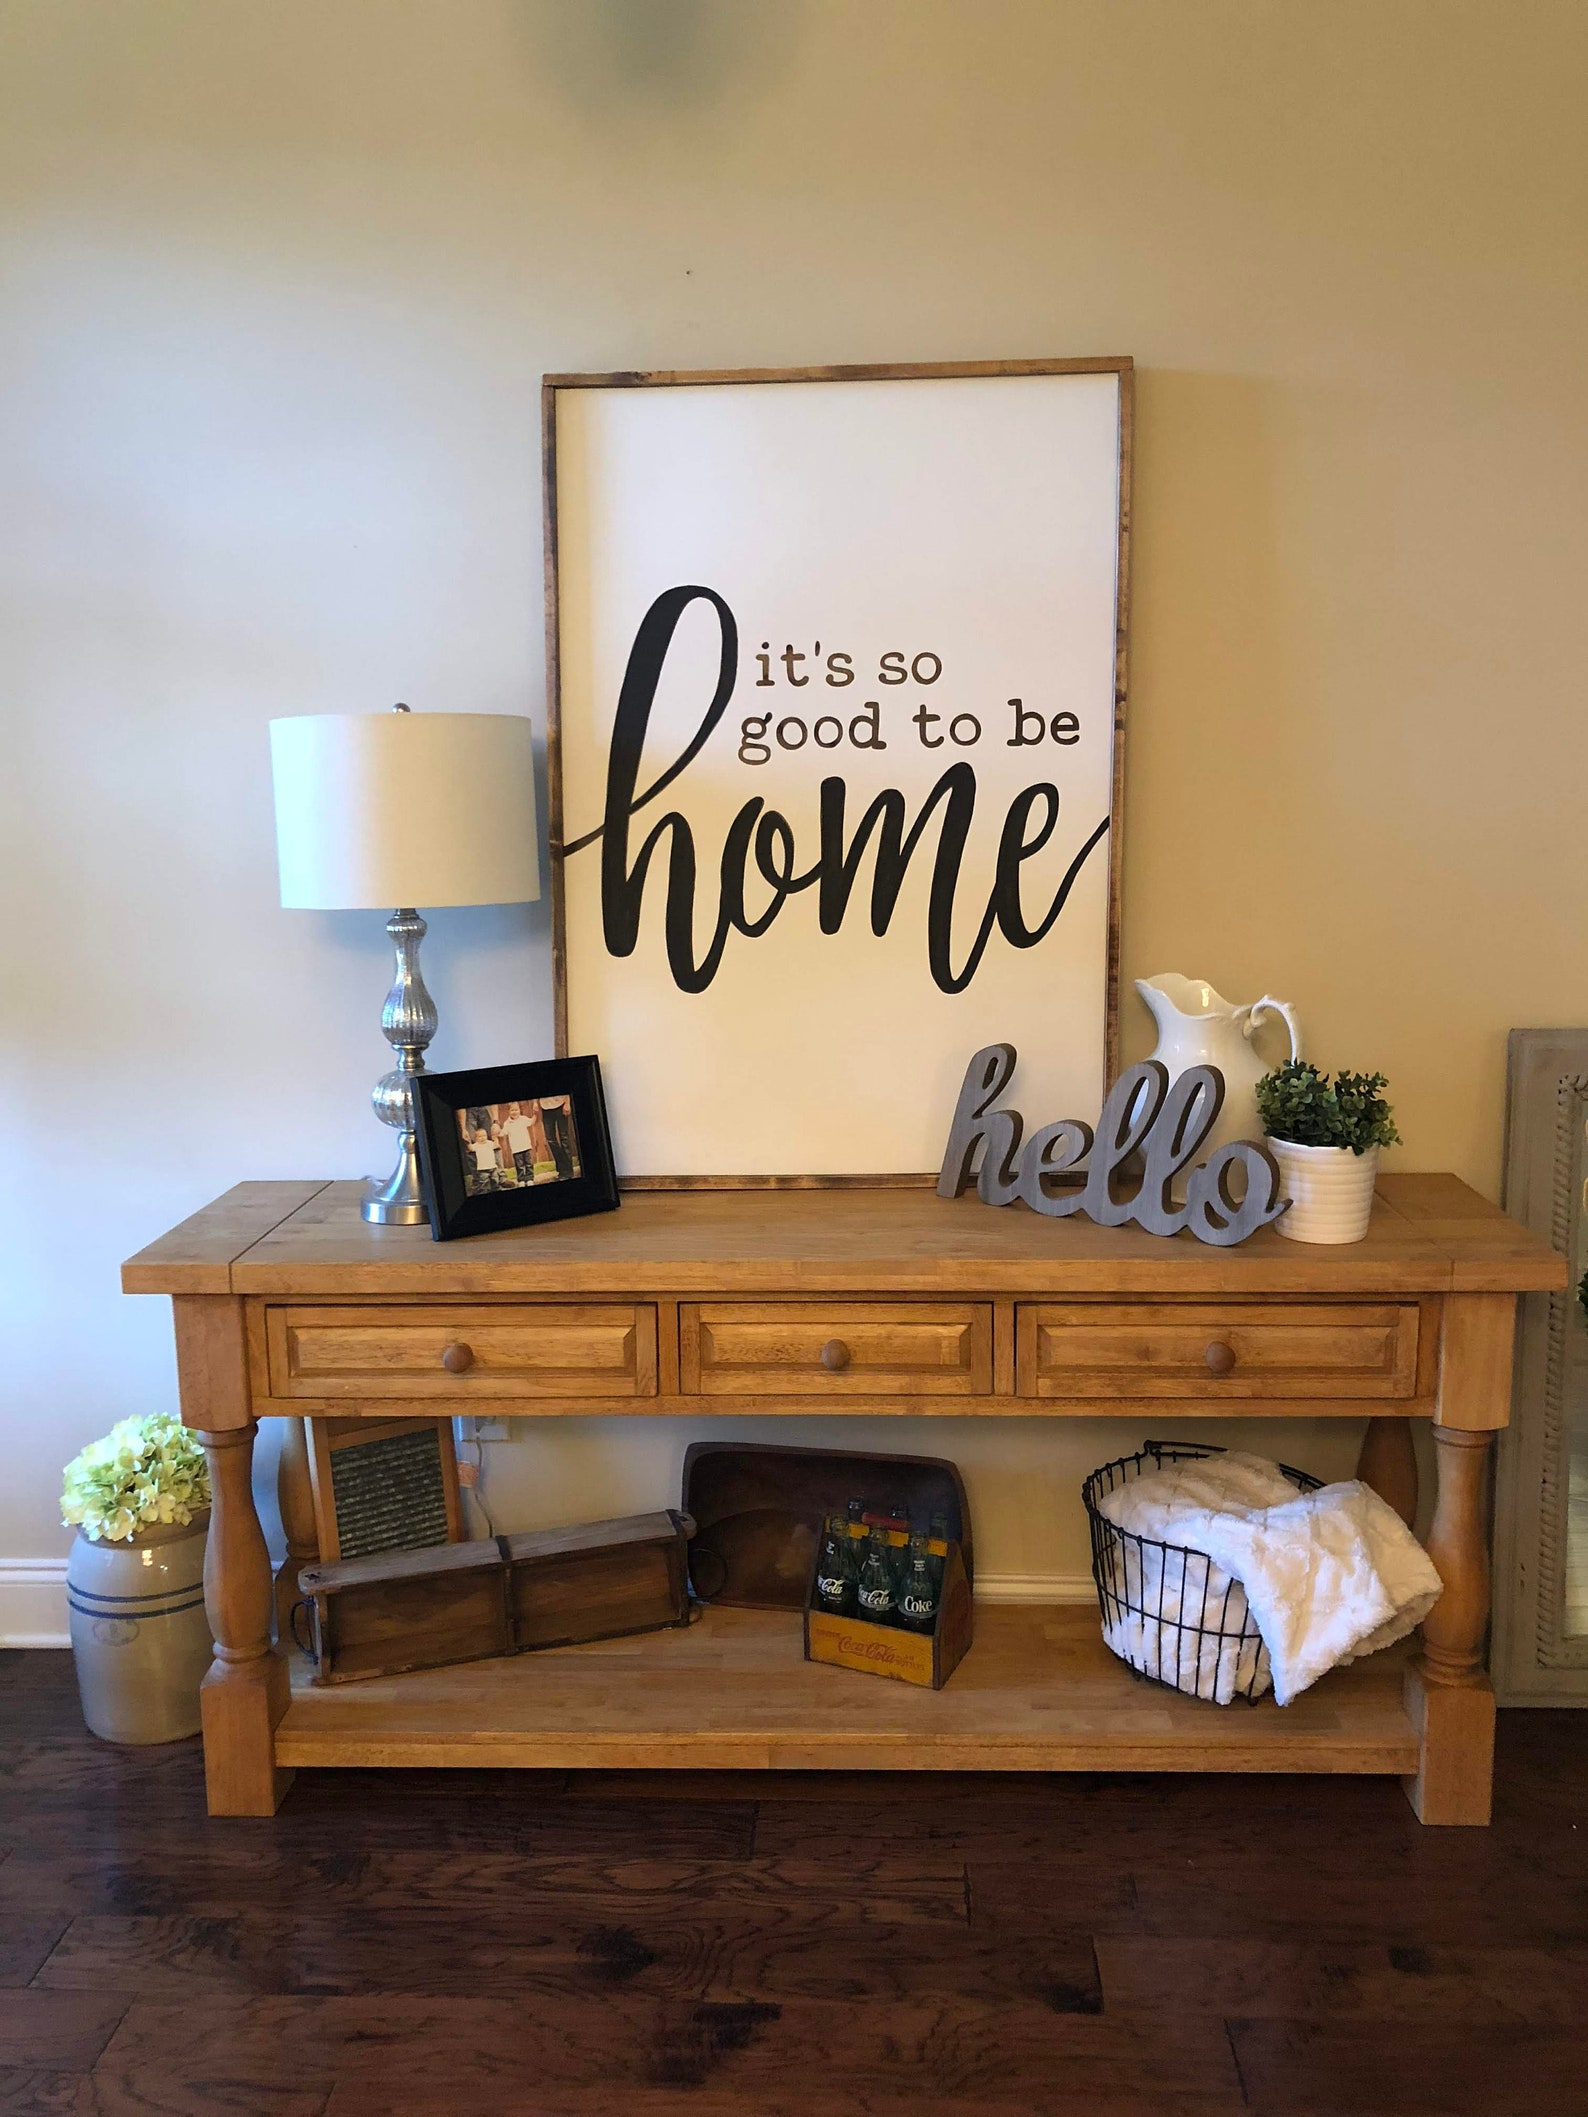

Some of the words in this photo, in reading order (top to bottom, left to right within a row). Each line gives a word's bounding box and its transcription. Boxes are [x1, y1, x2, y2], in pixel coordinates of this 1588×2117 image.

[755, 640, 856, 688] it's
[878, 651, 943, 686] so
[737, 700, 888, 766] good
[913, 704, 982, 748] to
[1006, 697, 1081, 746] be
[563, 585, 1111, 994] home
[936, 1042, 1294, 1247] hello
[904, 1595, 934, 1613] Coke
